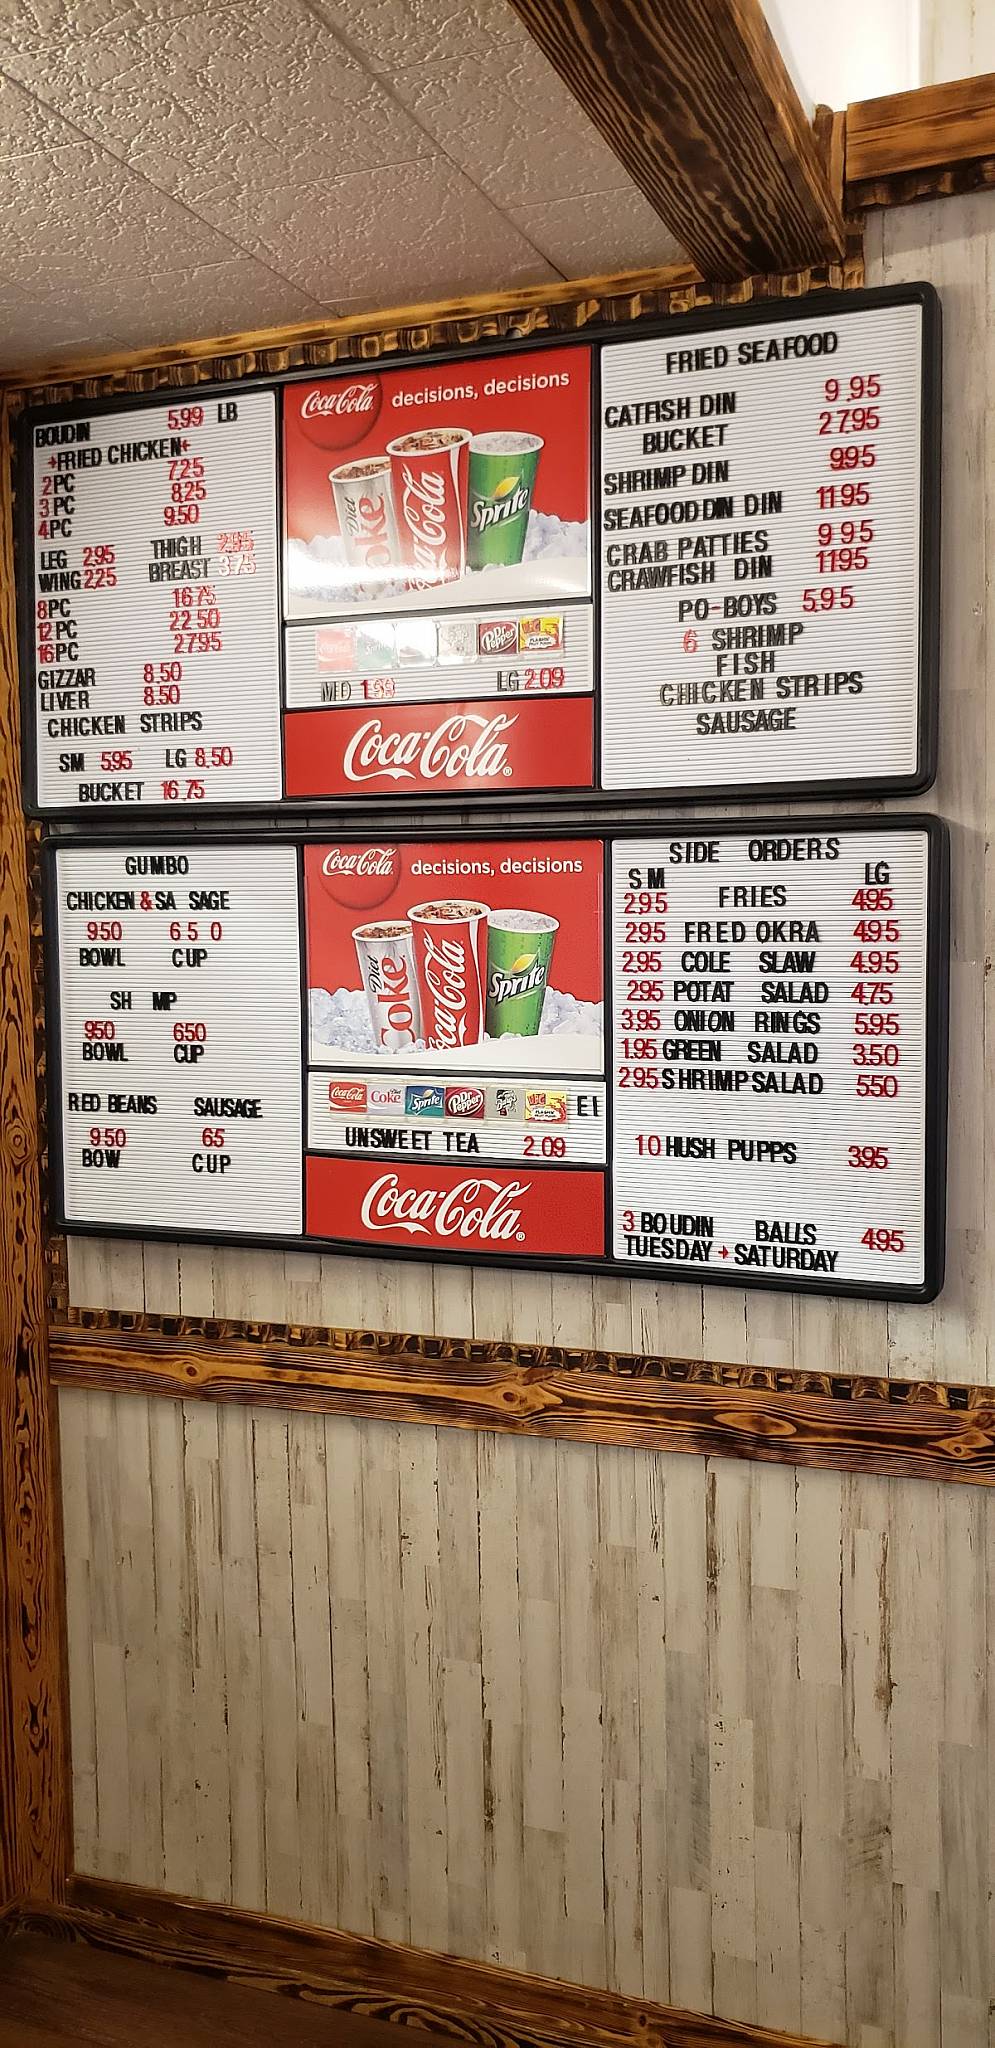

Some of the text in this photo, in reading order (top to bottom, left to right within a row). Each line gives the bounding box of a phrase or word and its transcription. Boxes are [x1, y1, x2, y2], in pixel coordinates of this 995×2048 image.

[666, 331, 838, 375] FRIED SEAFOOD
[301, 383, 378, 419] Coca-Cola
[392, 372, 570, 408] decisions, decisions
[605, 374, 881, 429] CATFISH DIN 9.95
[36, 422, 90, 448] BOUDIN
[217, 402, 238, 423] LB
[643, 424, 729, 455] BUCKET
[58, 437, 182, 471] FRIED CHICKEN
[604, 464, 686, 495] SHRIMP
[692, 460, 729, 484] DIN
[471, 486, 529, 532] Sprite
[603, 501, 698, 530] SEAFOOD
[745, 491, 782, 517] DIN
[41, 551, 67, 570] LEG
[150, 536, 201, 559] THIGH
[606, 540, 668, 567] CRAB
[678, 529, 768, 560] PATTIES
[39, 571, 81, 592] WING
[149, 558, 209, 582] BREAST
[607, 560, 715, 593] CRAWFISH
[734, 555, 772, 581] DIN
[678, 586, 855, 622] PO-BOYS 5.95
[484, 626, 516, 651] Dr Pepper
[683, 622, 804, 653] 6 SHRIMP
[38, 662, 182, 690] GIZZAR 8.50
[717, 651, 775, 677] FISH
[498, 671, 519, 692] LG
[660, 671, 864, 707] CHICKEN STRIPS
[41, 685, 180, 711] LIVER 8.50
[48, 711, 203, 738] CHICKEN STRIPS
[696, 707, 797, 735] SAUSAGE
[59, 753, 84, 772] SM
[166, 749, 187, 768] LG
[195, 747, 233, 768] 8.50
[79, 782, 144, 802] BUCKET
[322, 848, 397, 876] Coca-Cola
[670, 838, 840, 863] SIDE ORDERS
[126, 856, 189, 875] GUMBO
[411, 858, 583, 877] decisions, decisions
[865, 861, 889, 885] LG
[67, 891, 135, 910] CHICKEN
[140, 891, 152, 911] &
[719, 885, 786, 908] FRIES
[756, 920, 820, 944] OKRA
[80, 948, 207, 968] BOWL CUP
[681, 951, 730, 973] COLE
[758, 951, 816, 973] SLAW
[367, 955, 379, 993] Diet
[490, 965, 545, 1004] Sprite
[674, 981, 734, 1002] POTAT
[761, 981, 829, 1004] SALAD
[674, 1010, 735, 1031] ONION
[755, 1011, 821, 1034] RINGS
[83, 1043, 204, 1064] BOWL CUP
[663, 1040, 721, 1062] GREEN
[748, 1041, 818, 1064] SALAD
[68, 1093, 262, 1118] RED BEANS SAUSAGE
[371, 1090, 402, 1104] Coke
[412, 1094, 440, 1110] Sprite
[451, 1092, 482, 1116] Dr Pepper
[345, 1127, 566, 1158] UNSWEET TEA 2.09
[635, 1135, 661, 1156] 10
[666, 1136, 715, 1159] HUSH
[728, 1140, 797, 1164] PUPPS
[82, 1149, 231, 1173] BOW CUP
[623, 1210, 635, 1232] 3
[641, 1212, 713, 1238] BOUDIN
[756, 1220, 816, 1245] BALLS
[624, 1235, 838, 1272] TUESDAY SATURDAY
